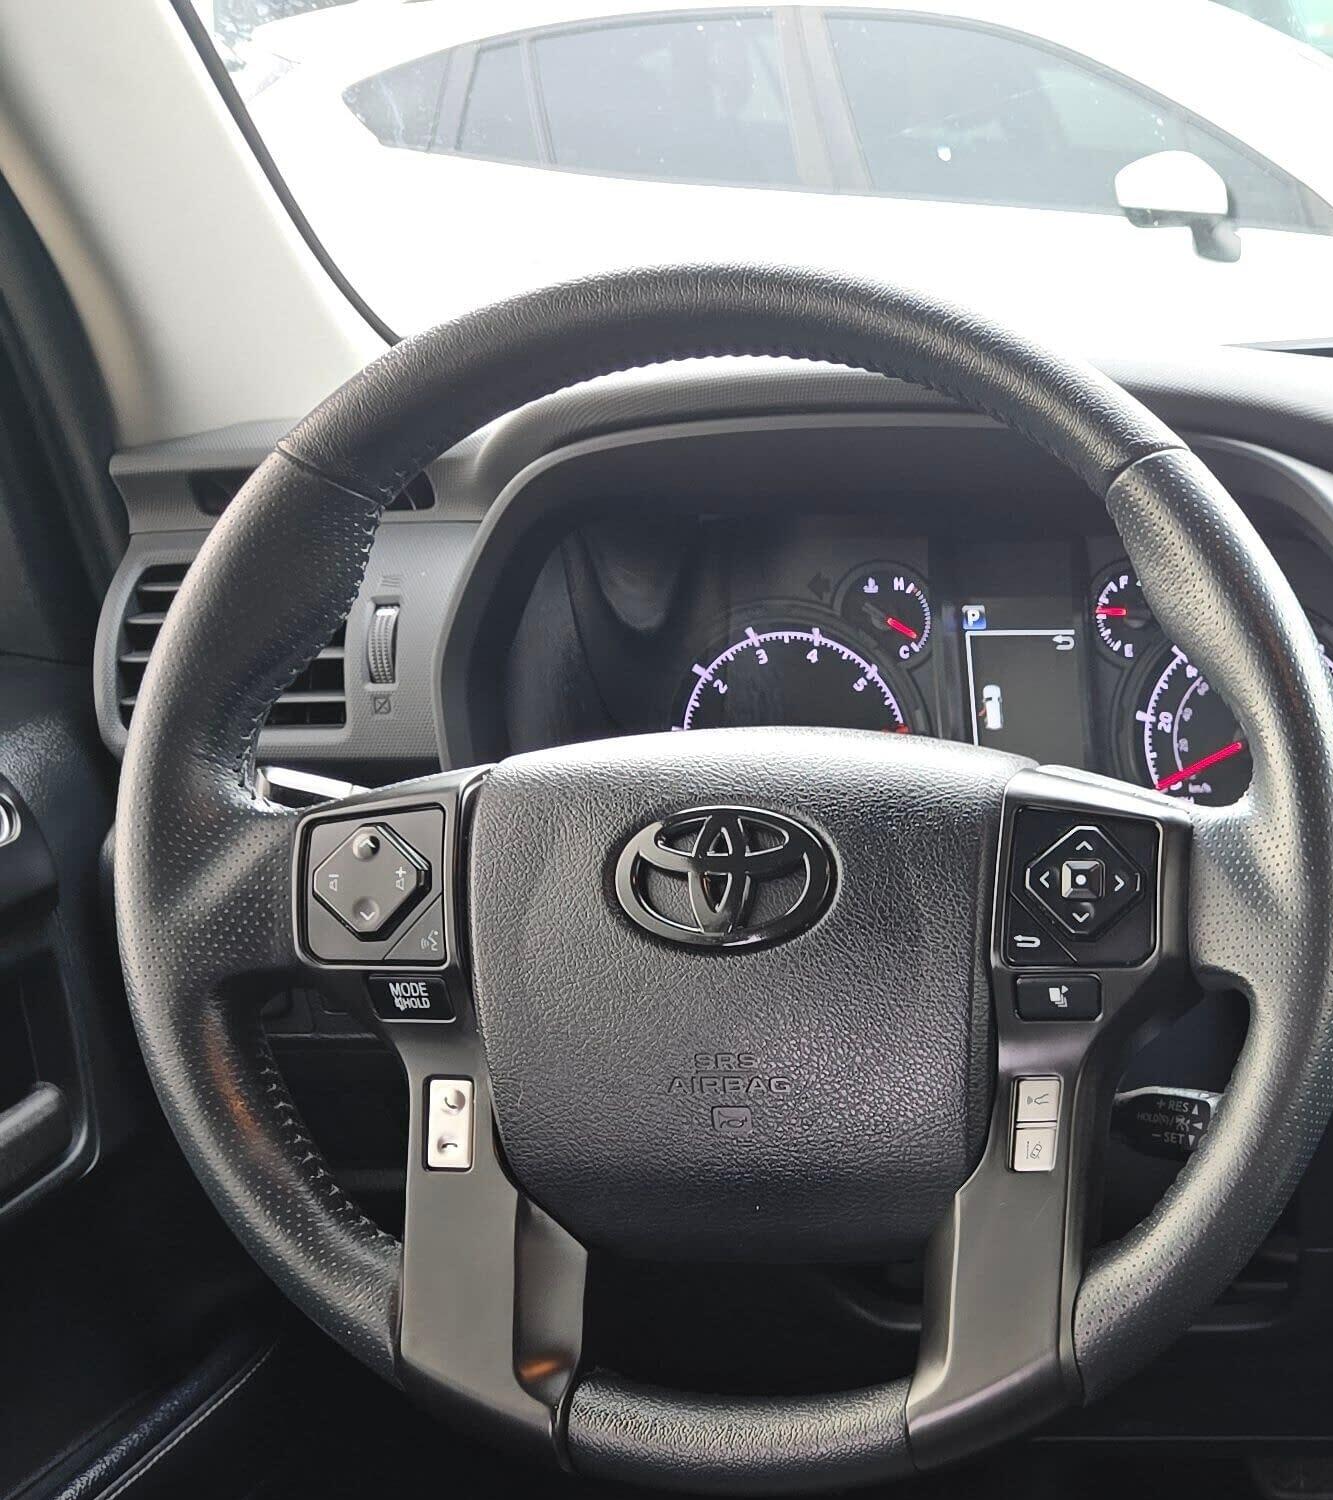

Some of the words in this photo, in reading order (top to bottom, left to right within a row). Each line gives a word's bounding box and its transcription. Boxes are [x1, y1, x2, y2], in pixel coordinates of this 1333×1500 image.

[893, 576, 905, 591] H
[966, 609, 981, 627] P
[755, 649, 768, 665] 3
[805, 649, 819, 664] 4
[899, 645, 910, 659] C
[713, 678, 728, 694] 2
[852, 676, 868, 692] 5
[1157, 711, 1174, 733] 20
[388, 982, 429, 997] MODE
[403, 997, 431, 1009] HOLD
[693, 1053, 758, 1069] SRS
[667, 1076, 794, 1095] AIRBAG
